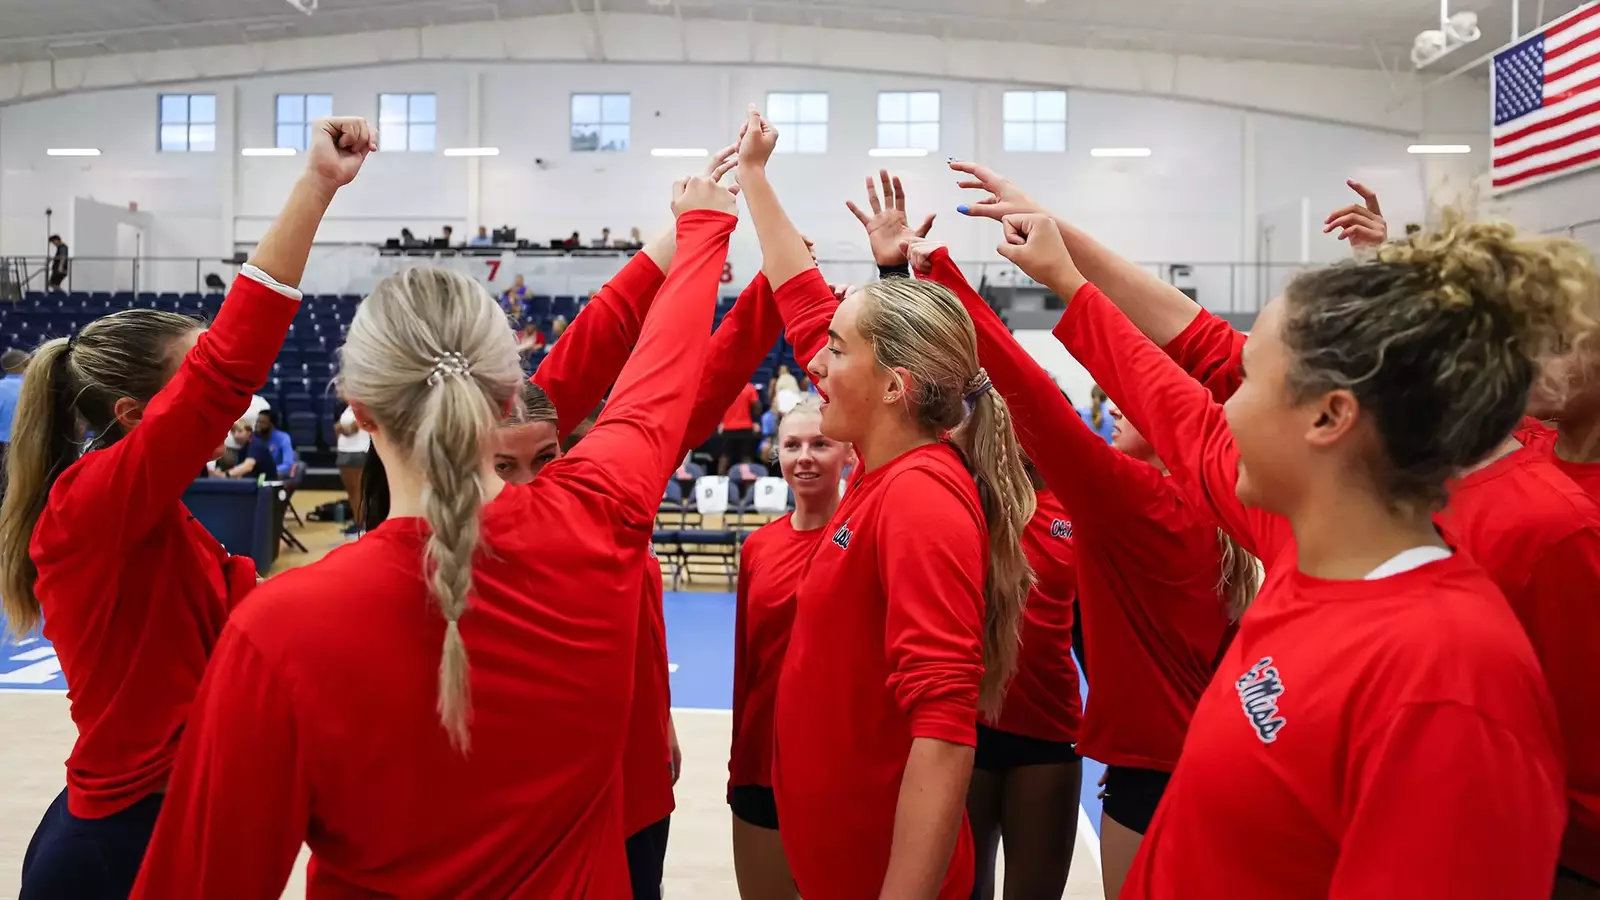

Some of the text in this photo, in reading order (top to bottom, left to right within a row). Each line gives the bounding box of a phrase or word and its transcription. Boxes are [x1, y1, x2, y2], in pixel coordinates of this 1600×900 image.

[485, 260, 502, 281] 7
[720, 262, 733, 284] 8
[1240, 666, 1287, 744] Miss
